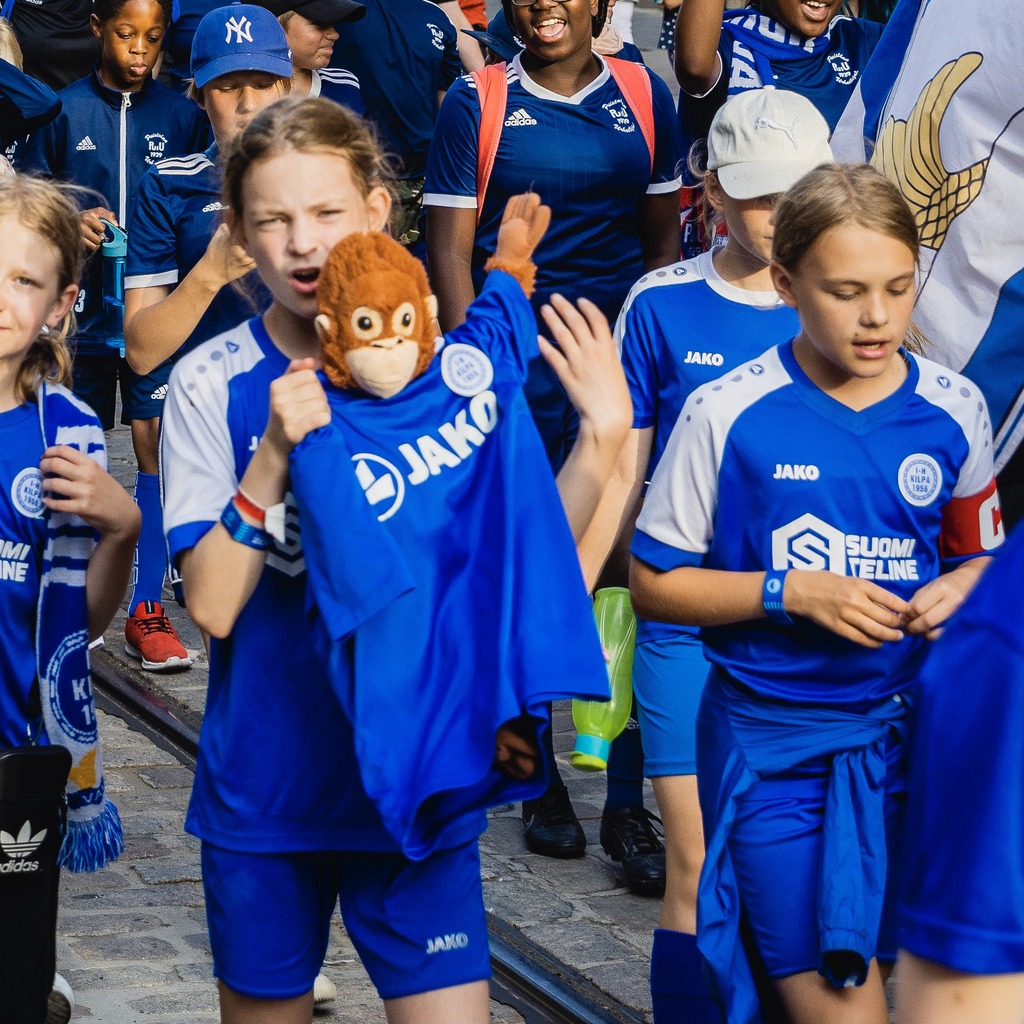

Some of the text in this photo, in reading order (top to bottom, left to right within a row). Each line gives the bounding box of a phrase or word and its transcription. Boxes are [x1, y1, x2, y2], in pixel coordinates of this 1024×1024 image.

[225, 15, 254, 44] NY
[504, 117, 537, 126] adidas
[76, 144, 97, 152] adidas
[149, 141, 165, 151] PuiU
[684, 351, 723, 366] JAKO
[398, 390, 498, 486] JAKO
[773, 463, 820, 481] JAKO
[910, 475, 931, 484] KILPA
[915, 466, 926, 475] I-H
[979, 490, 1006, 551] C
[845, 534, 917, 558] SUOMI
[847, 558, 920, 581] TELINE
[426, 932, 468, 955] JAKO
